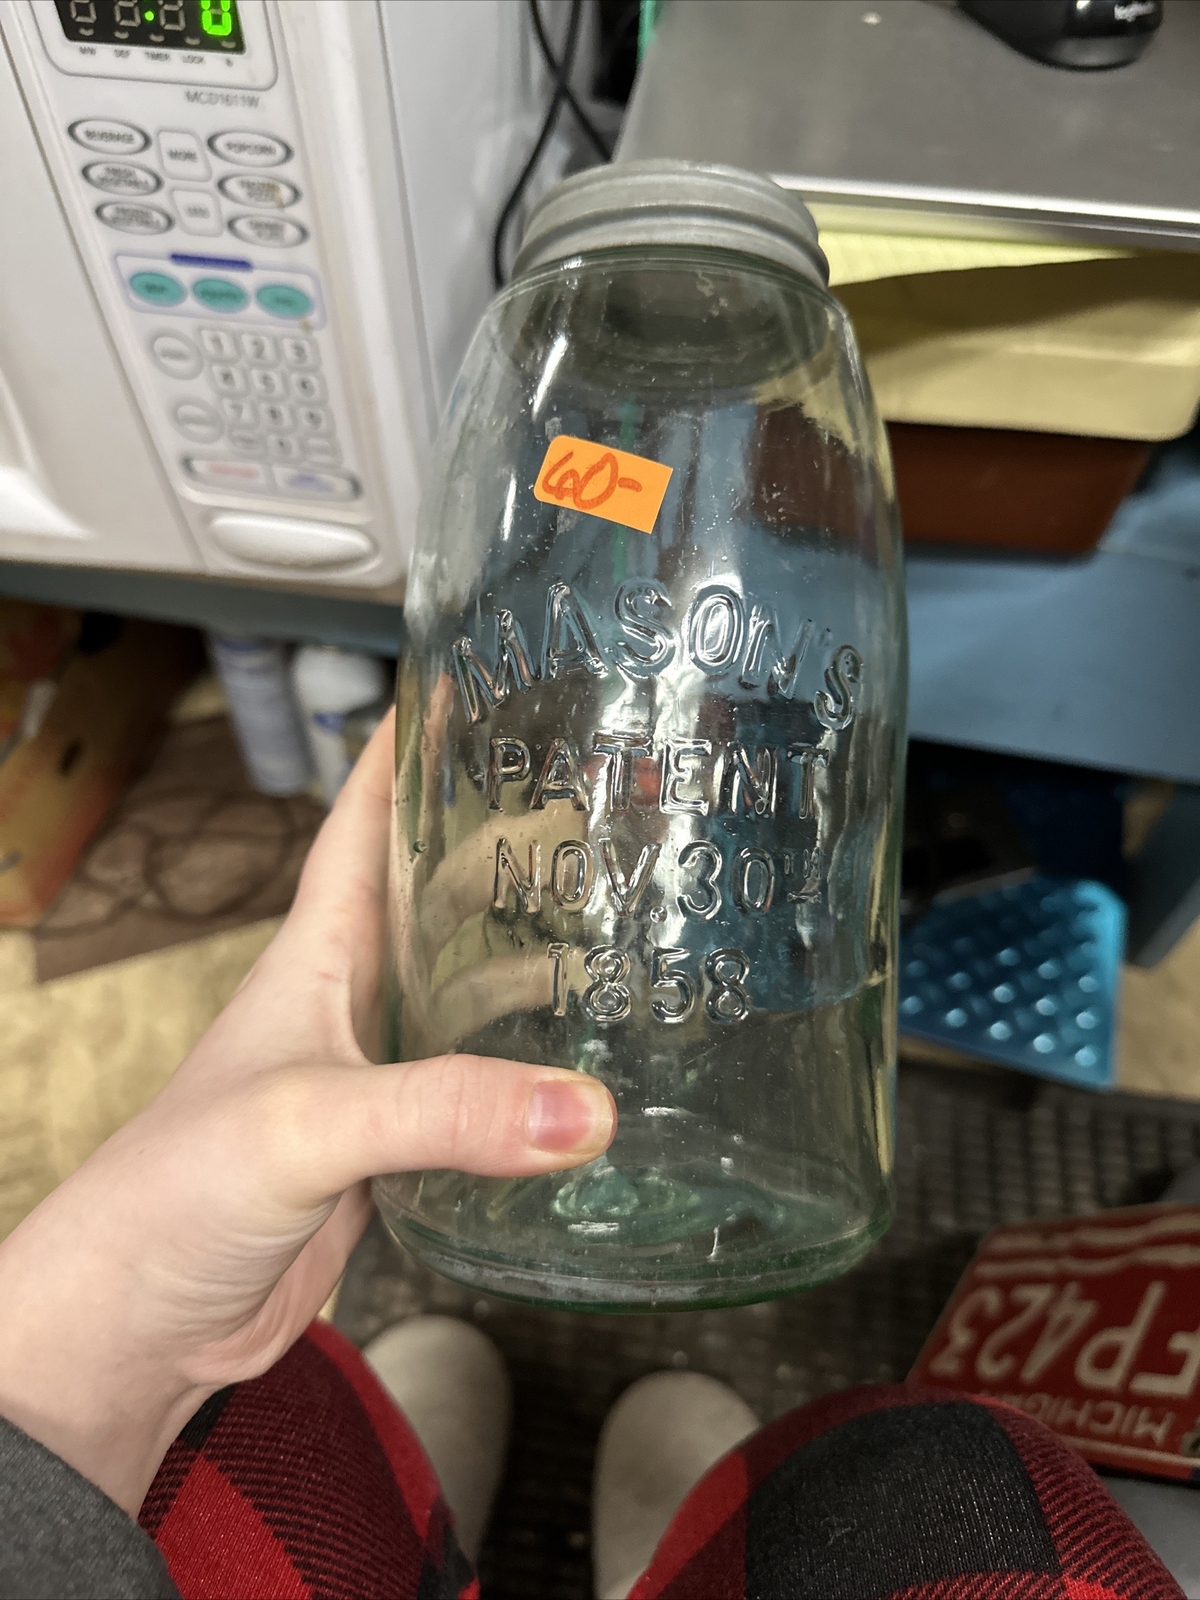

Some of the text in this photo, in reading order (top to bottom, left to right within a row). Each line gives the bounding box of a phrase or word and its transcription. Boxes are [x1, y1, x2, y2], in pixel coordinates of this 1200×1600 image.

[488, 731, 831, 820] PATENT
[546, 943, 751, 1024] 1858
[980, 1391, 1177, 1447] MICHIG
